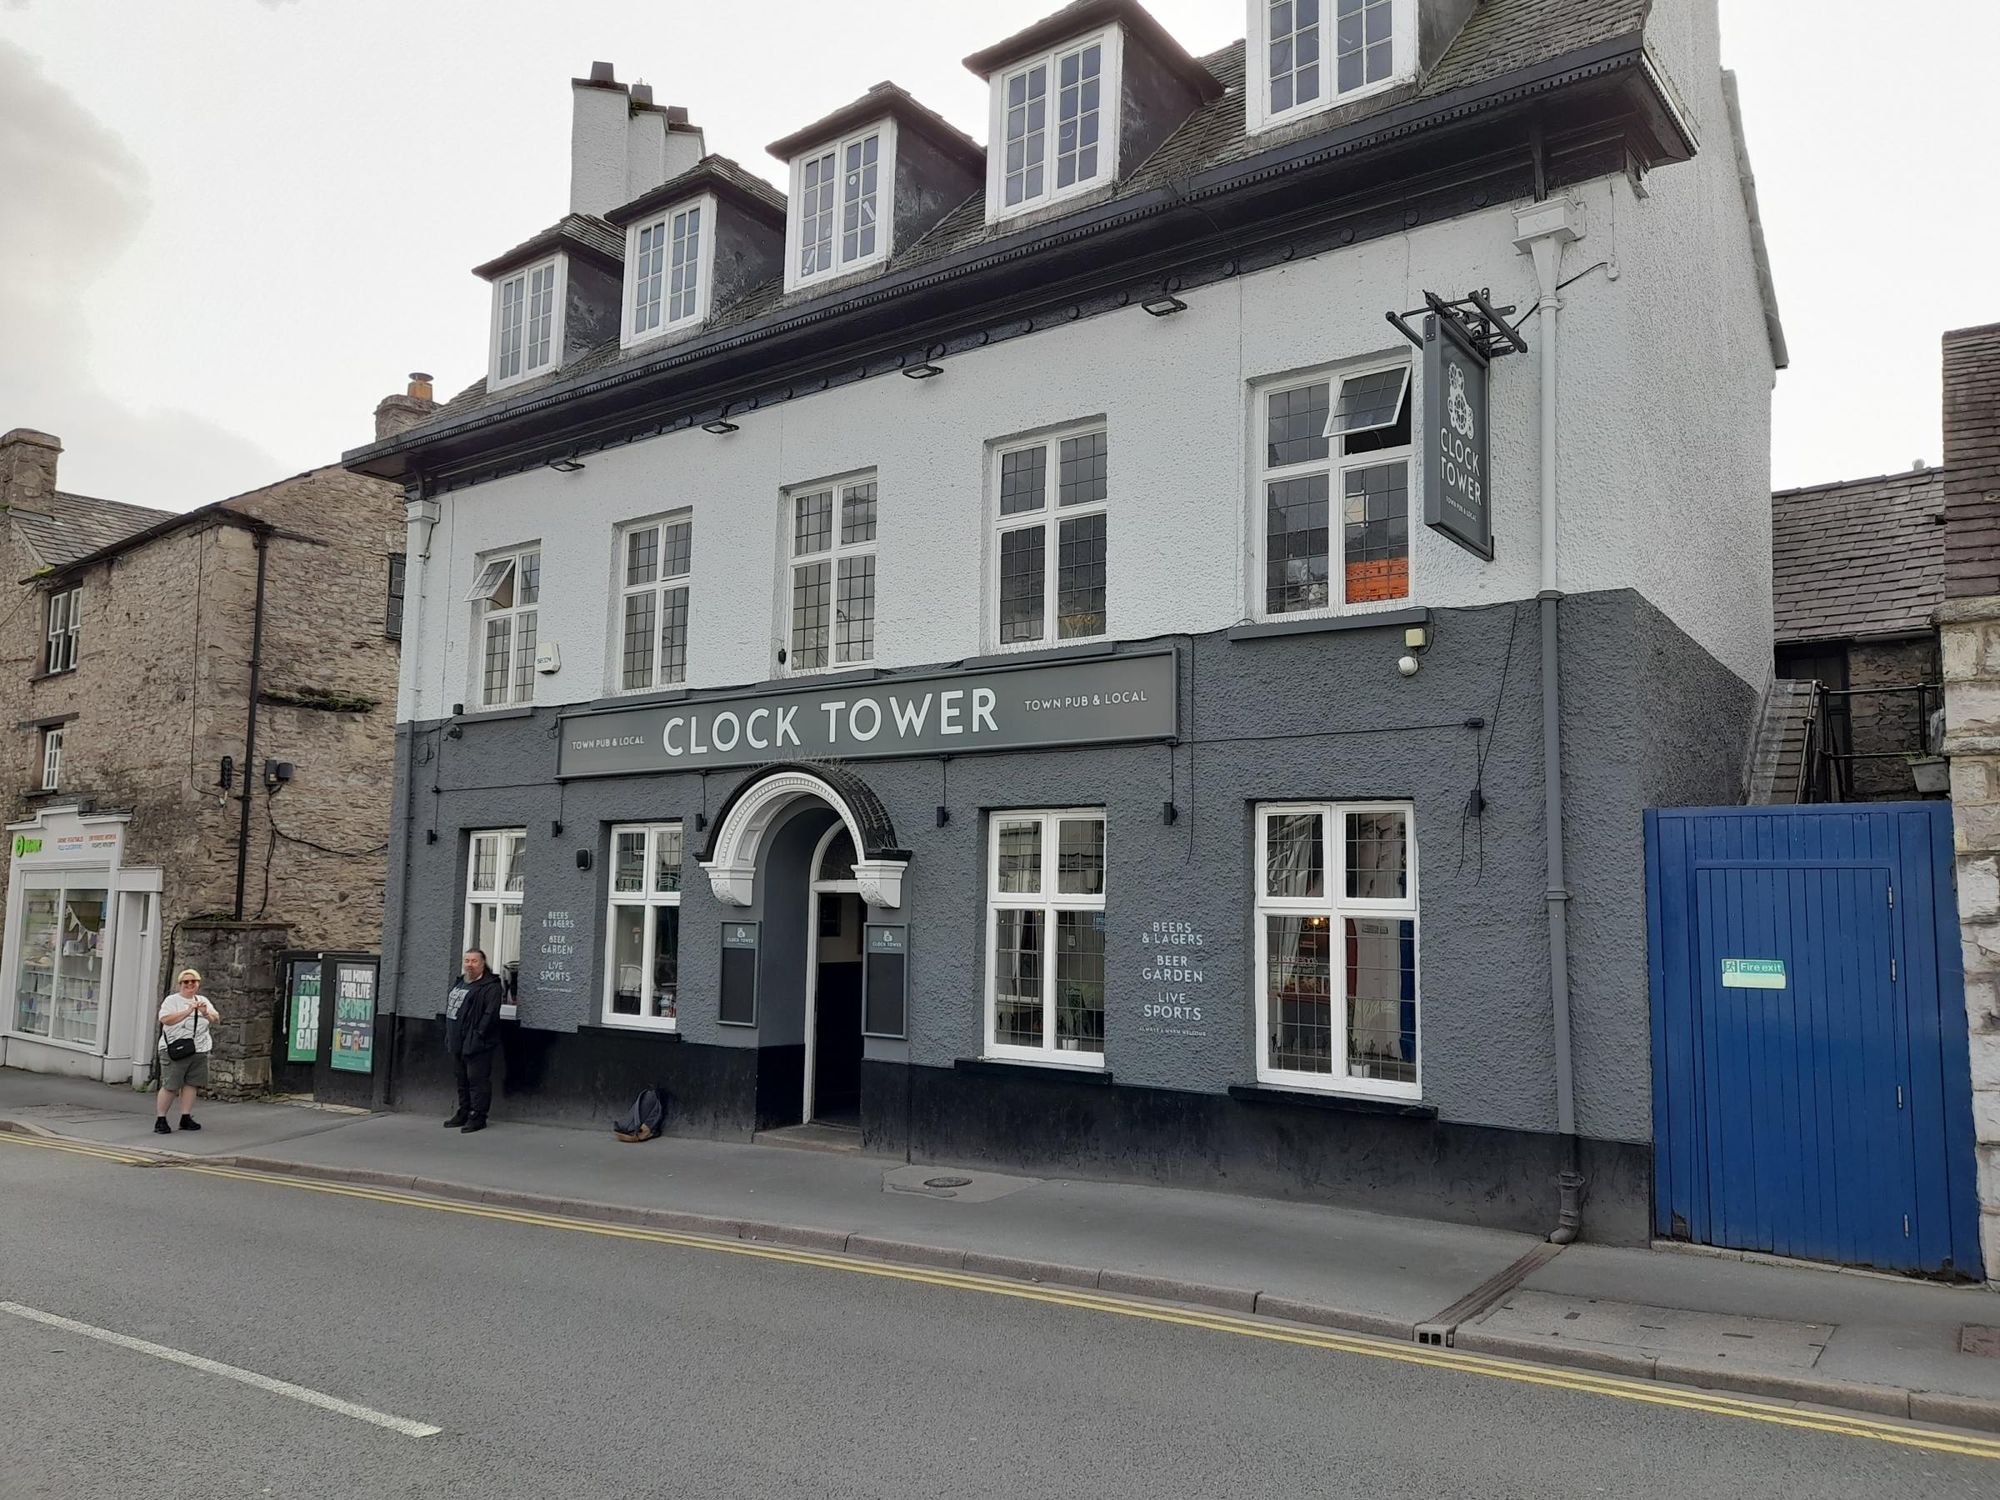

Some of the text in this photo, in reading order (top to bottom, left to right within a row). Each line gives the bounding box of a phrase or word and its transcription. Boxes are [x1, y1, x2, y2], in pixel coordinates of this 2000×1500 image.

[1440, 428, 1480, 477] CLOCK
[1441, 456, 1482, 506] TOWER
[1024, 690, 1148, 711] TOWN PUB & LOCAL
[662, 687, 1000, 756] CLOCK TOWER
[572, 736, 645, 750] TOWN PUB & LOCAL
[548, 911, 569, 920] BEERS
[548, 920, 575, 928] LAGERS
[1152, 922, 1192, 934] BEERS
[548, 935, 566, 944] BEER
[1142, 932, 1203, 946] & LAGERS
[541, 944, 573, 955] GARDEN
[548, 961, 564, 970] LIVE
[1156, 954, 1188, 967] BEER
[1740, 962, 1782, 972] Fire exit
[540, 970, 571, 981] SPORTS
[1142, 967, 1203, 983] GARDEN
[1158, 992, 1186, 1004] LIVE
[338, 999, 372, 1020] SPORT
[1143, 1004, 1201, 1020] SPORTS
